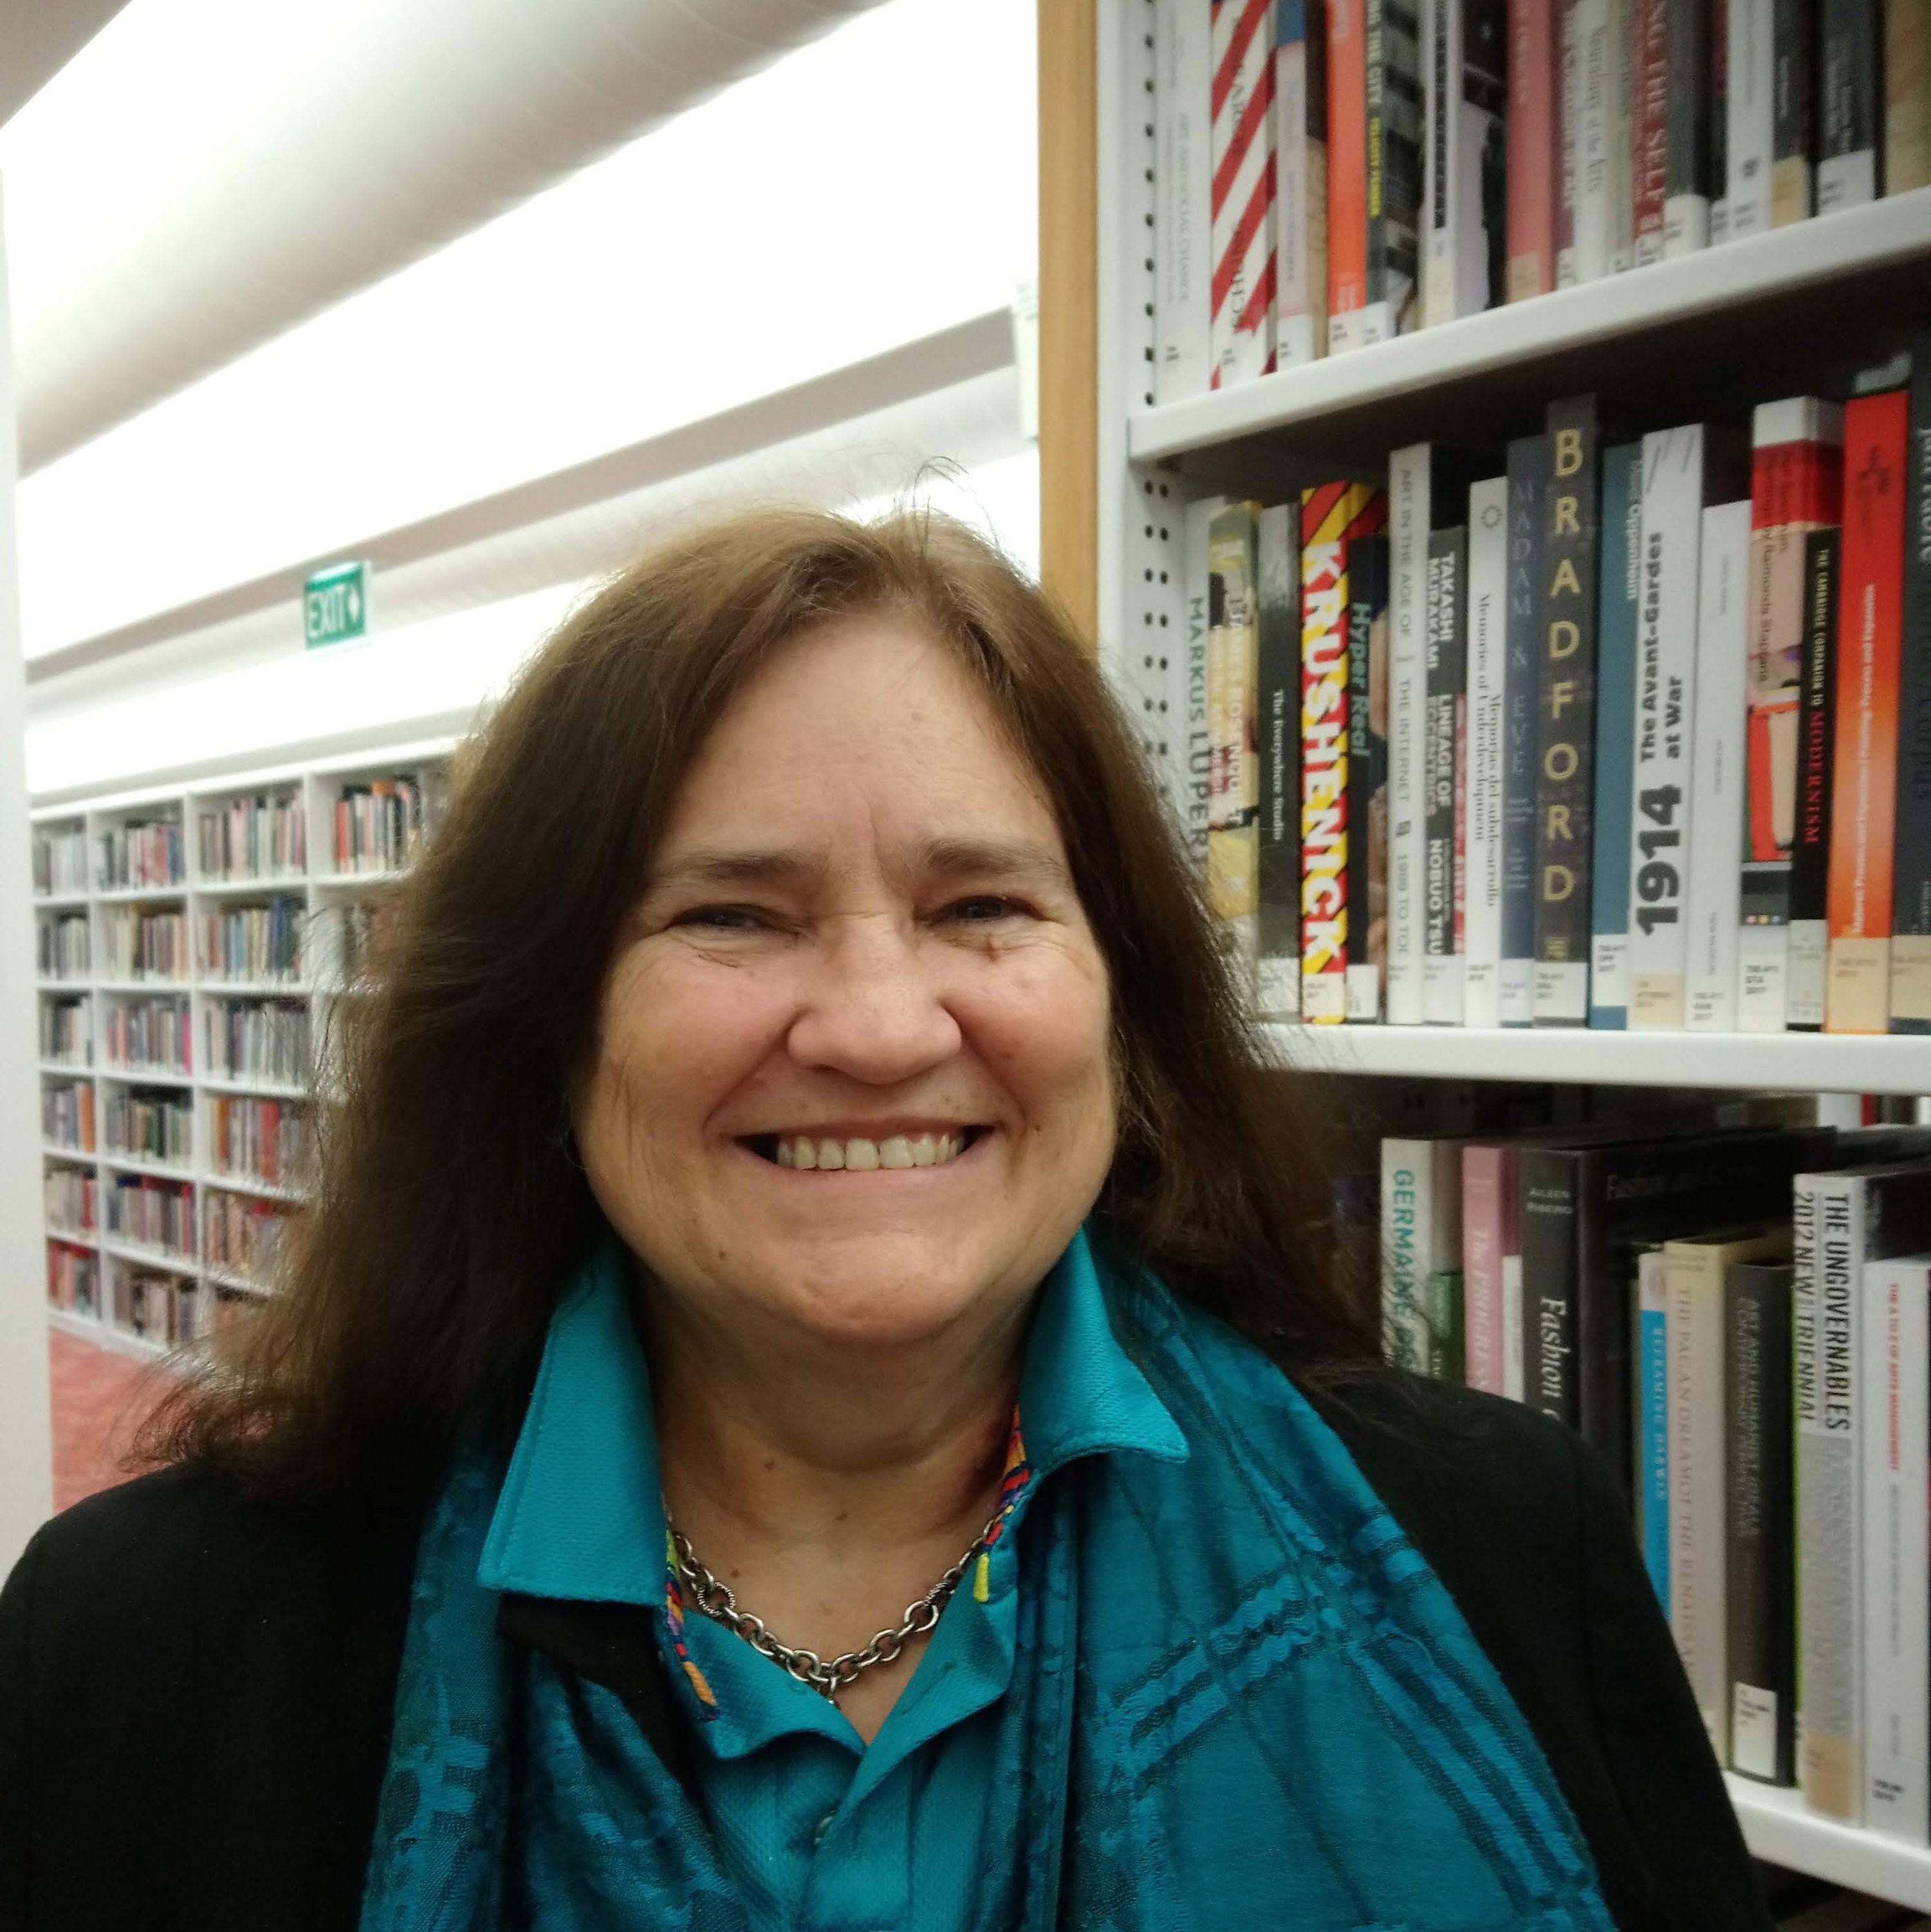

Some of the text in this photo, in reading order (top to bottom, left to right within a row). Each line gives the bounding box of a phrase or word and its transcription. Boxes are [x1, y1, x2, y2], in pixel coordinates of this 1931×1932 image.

[1177, 237, 1190, 304] CHANGE
[1400, 469, 1414, 504] ART
[1400, 508, 1413, 528] IN
[1400, 534, 1413, 567] THE
[1817, 548, 1830, 568] THE
[307, 583, 346, 639] EXIT
[1399, 613, 1412, 638] OF
[1400, 572, 1413, 608] AGE
[1427, 558, 1441, 668] MURAKAMI
[1439, 551, 1455, 640] TAKASHI
[1188, 597, 1206, 723] MARKUS
[1477, 593, 1492, 669] Memories
[1542, 427, 1584, 902] BRADFORD
[1273, 689, 1285, 715] The
[1349, 602, 1372, 758] Hyper Real
[1398, 679, 1412, 711] THE
[1665, 676, 1683, 759] at War
[1302, 540, 1343, 959] KRUSHENICK
[1398, 716, 1411, 803] INTERNET
[1436, 692, 1453, 808] LINEAGE OF
[1471, 694, 1493, 842] Underdevelopment
[1486, 693, 1503, 772] Memorias
[1636, 532, 1683, 936] 1914 The Avant-Gardes
[1486, 774, 1502, 797] del
[1804, 709, 1826, 844] MODERNISM
[1273, 797, 1285, 841] Studio
[1428, 839, 1444, 954] NOBUO TSU
[1391, 1168, 1417, 1317] GERMAINE
[1793, 1191, 1816, 1241] 2012
[1824, 1193, 1852, 1236] THE
[1676, 1286, 1693, 1323] THE
[1793, 1244, 1816, 1296] NEW
[1540, 1296, 1571, 1399] Fashion
[1677, 1329, 1693, 1402] PAGAN
[1824, 1240, 1852, 1431] UNGOVERNABLES
